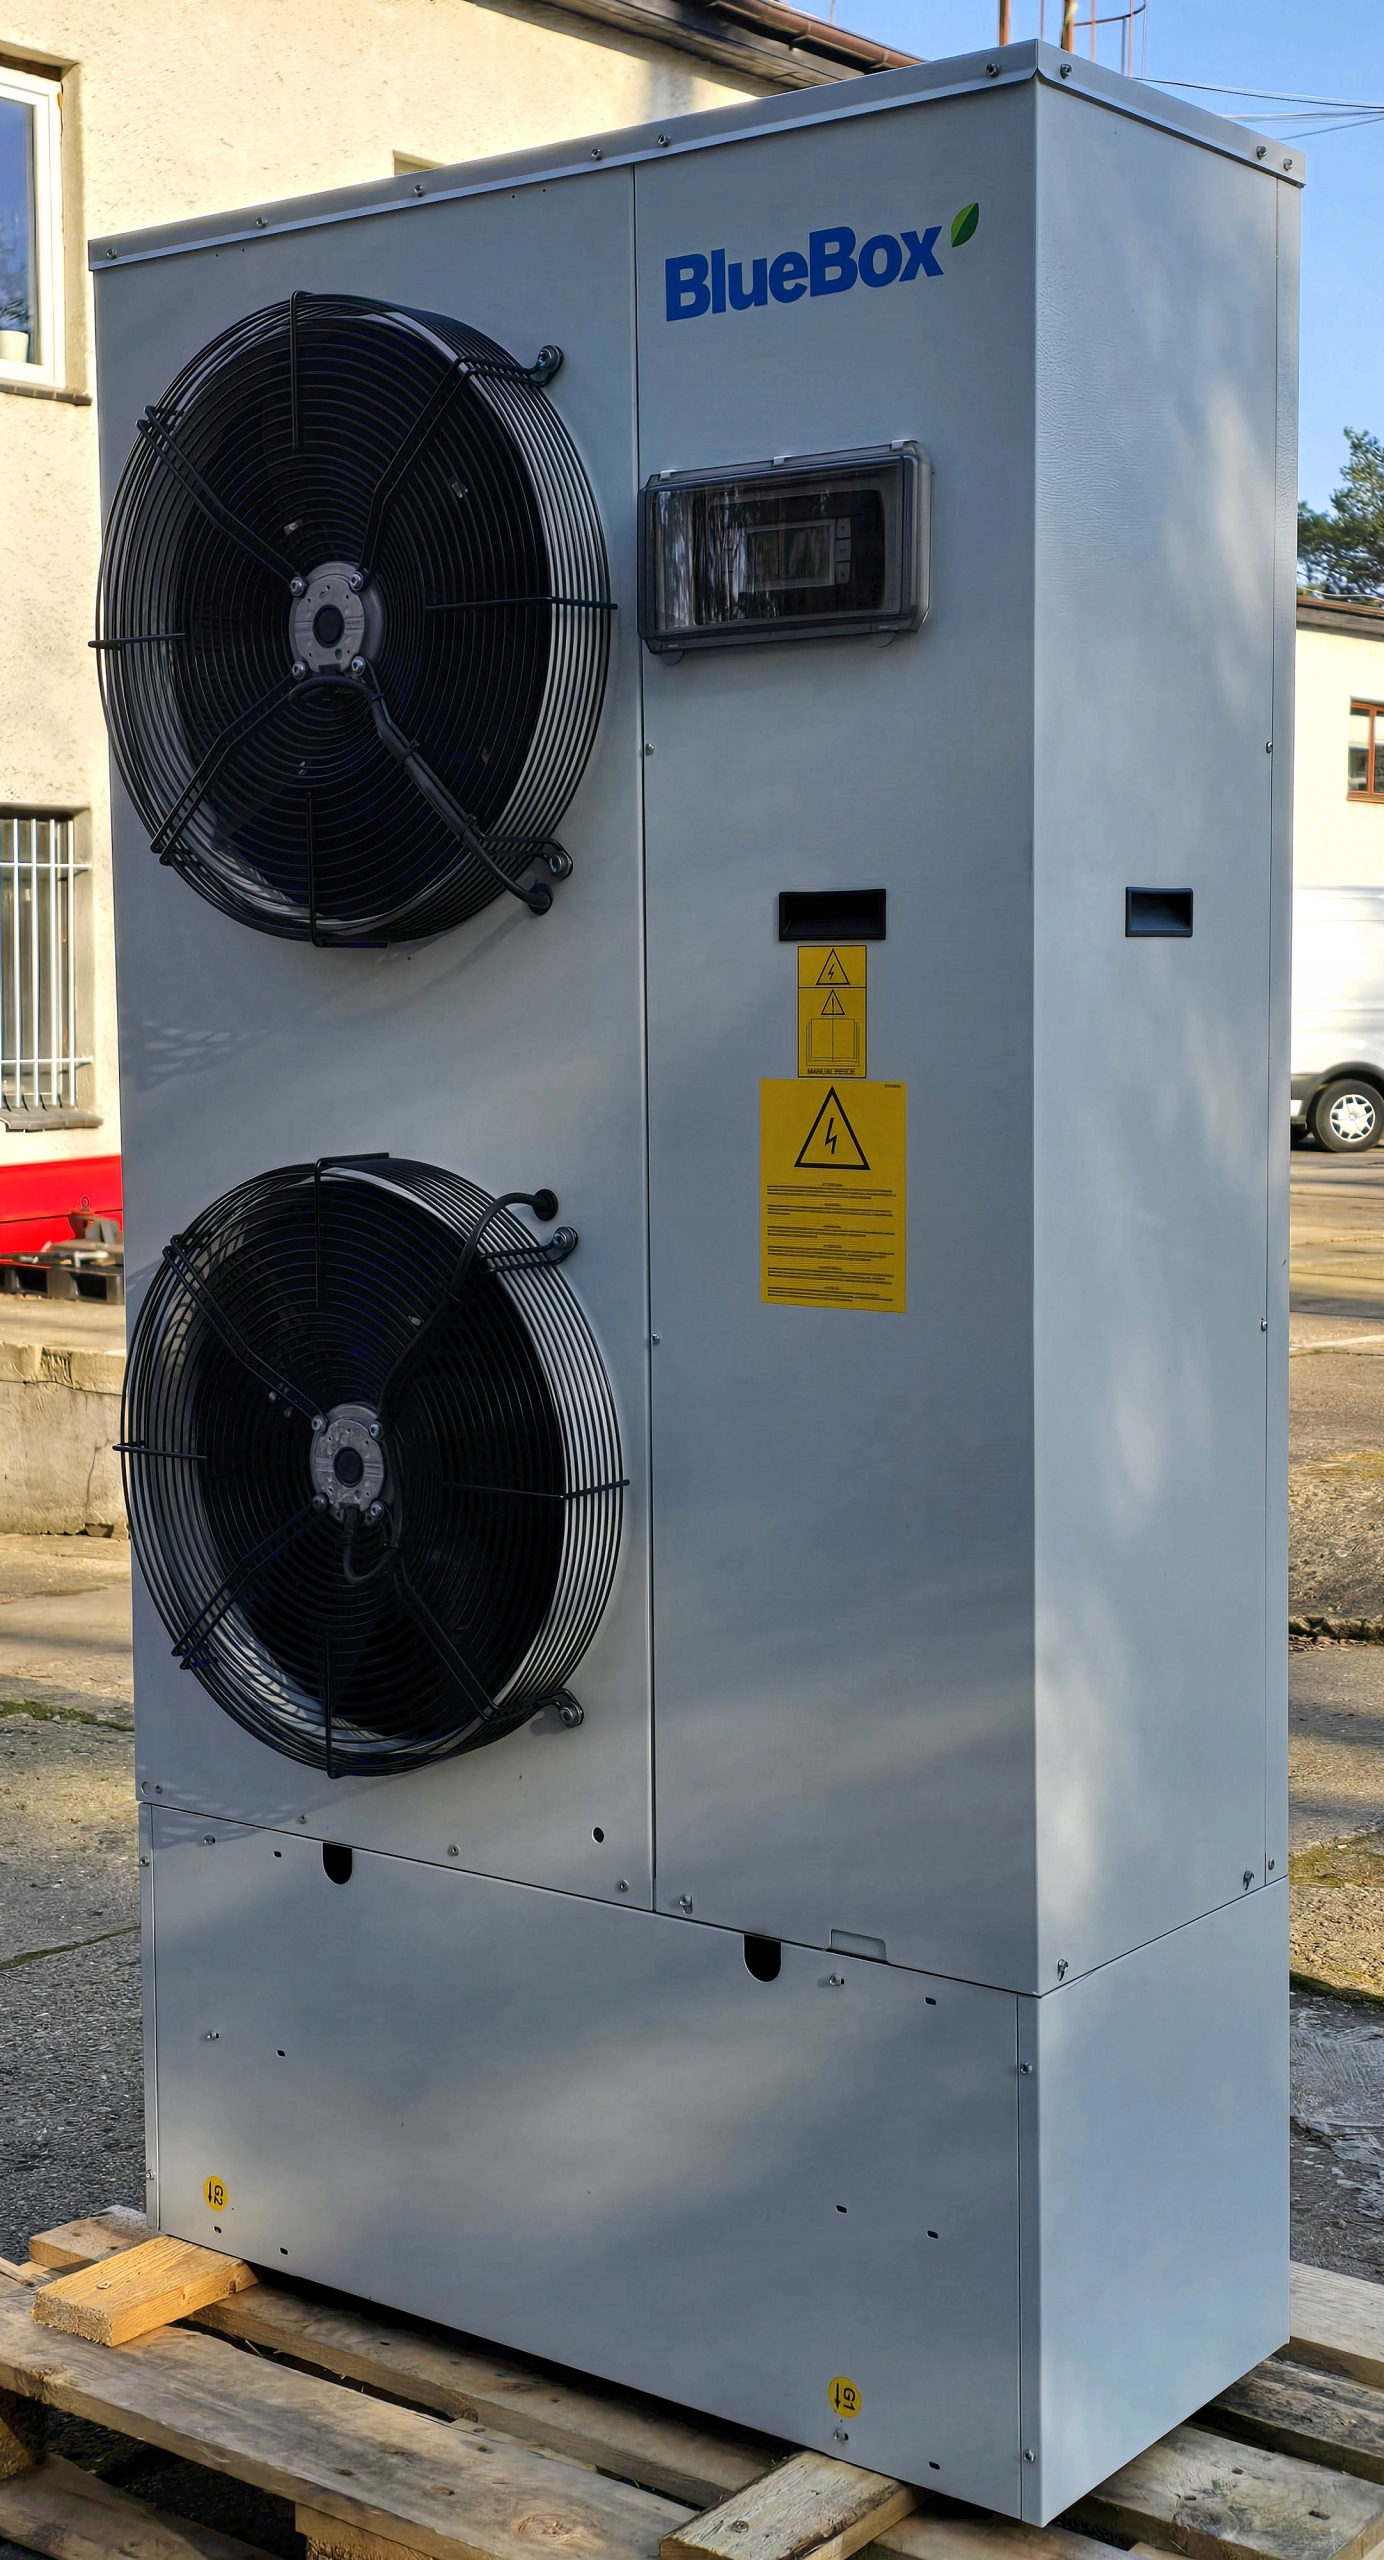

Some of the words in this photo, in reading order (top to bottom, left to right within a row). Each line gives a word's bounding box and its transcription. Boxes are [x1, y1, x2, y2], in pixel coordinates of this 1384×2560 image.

[664, 225, 944, 322] BlueBox
[213, 2185, 223, 2206] G2
[843, 2387, 856, 2411] G1
